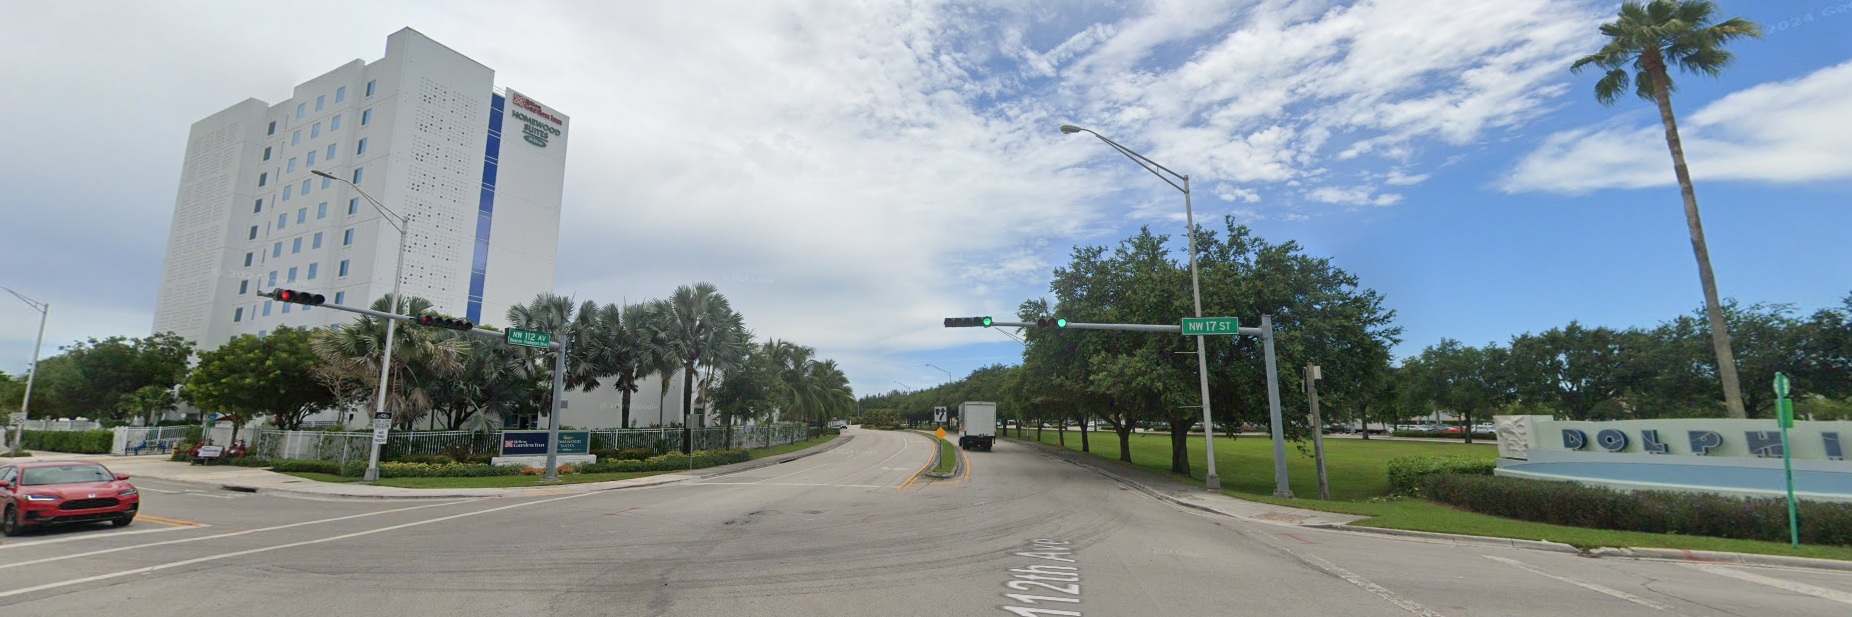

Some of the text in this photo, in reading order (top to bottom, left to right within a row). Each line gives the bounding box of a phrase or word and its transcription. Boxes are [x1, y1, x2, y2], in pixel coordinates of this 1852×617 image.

[511, 110, 561, 137] HOMEWOOD
[523, 123, 549, 140] SUITES
[1189, 321, 1231, 332] NW 17 ST
[512, 331, 547, 342] NW 112 AV
